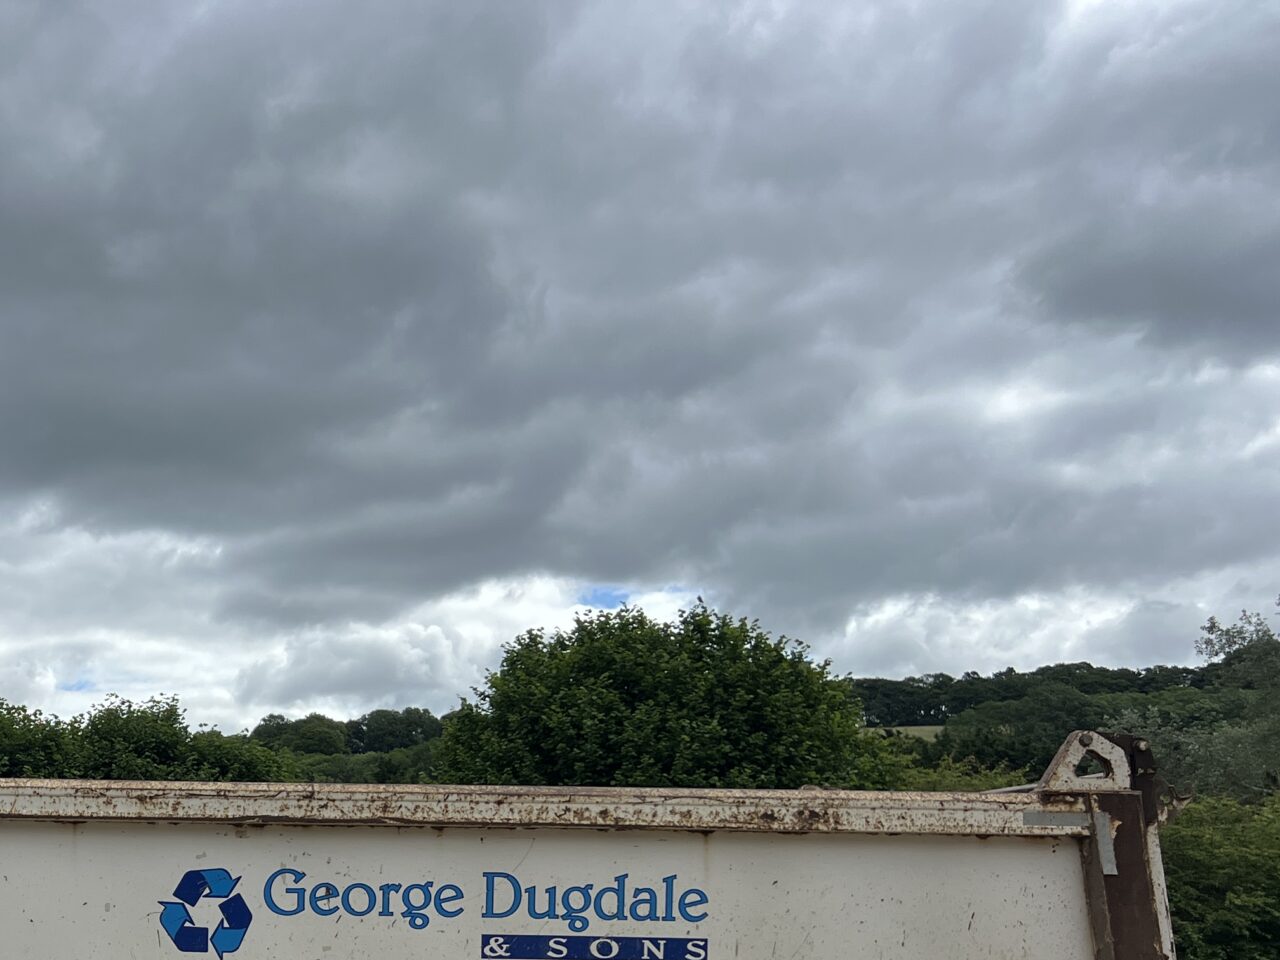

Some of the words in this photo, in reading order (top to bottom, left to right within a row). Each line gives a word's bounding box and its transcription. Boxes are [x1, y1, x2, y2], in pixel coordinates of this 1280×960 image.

[263, 868, 465, 930] George
[481, 871, 709, 932] Dugdale
[483, 936, 511, 957] &
[546, 937, 707, 960] SONS
